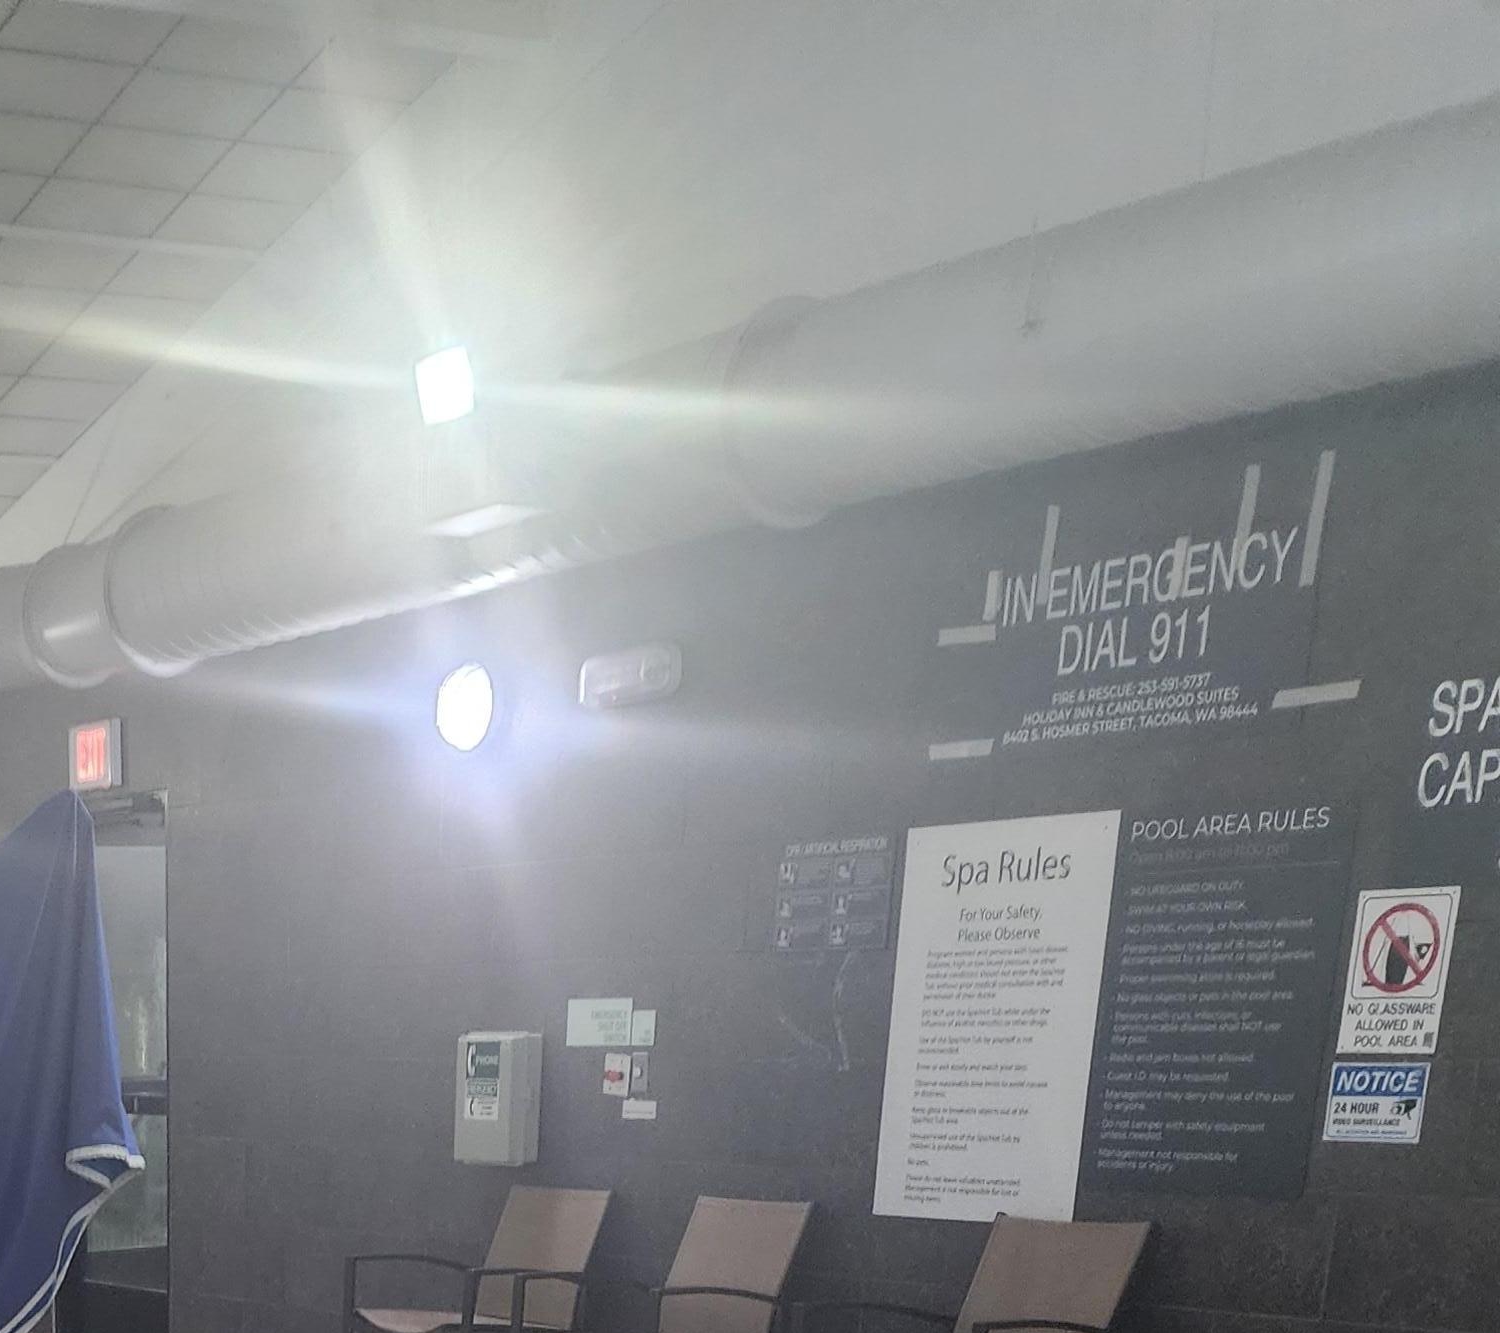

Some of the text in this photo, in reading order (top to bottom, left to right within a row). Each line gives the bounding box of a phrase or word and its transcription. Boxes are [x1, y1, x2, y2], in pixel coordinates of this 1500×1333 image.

[1002, 526, 1299, 628] IN EMERGENCY
[1057, 604, 1210, 676] DIAL 911
[1022, 708, 1072, 728] HOLIDAY
[1073, 705, 1095, 721] INN
[1106, 692, 1195, 716] CANDLEWOOD
[1197, 685, 1240, 702] SUITES
[1051, 689, 1075, 706] FIRE
[1042, 720, 1090, 740] HOSMER
[1195, 706, 1217, 722] WA
[1131, 805, 1331, 842] POOL AREA RULES
[941, 846, 1072, 894] Spa Rules
[959, 907, 977, 922] For
[980, 906, 1003, 922] Your
[957, 926, 1041, 943] Please Observe
[1346, 1002, 1436, 1016] NO GLASSWARE
[1354, 1018, 1425, 1031] ALLOWED IN
[1354, 1035, 1383, 1047] POOL
[1387, 1034, 1417, 1047] AREA
[1336, 1069, 1421, 1092] NOTICE
[1333, 1101, 1380, 1114] 24 HOUR
